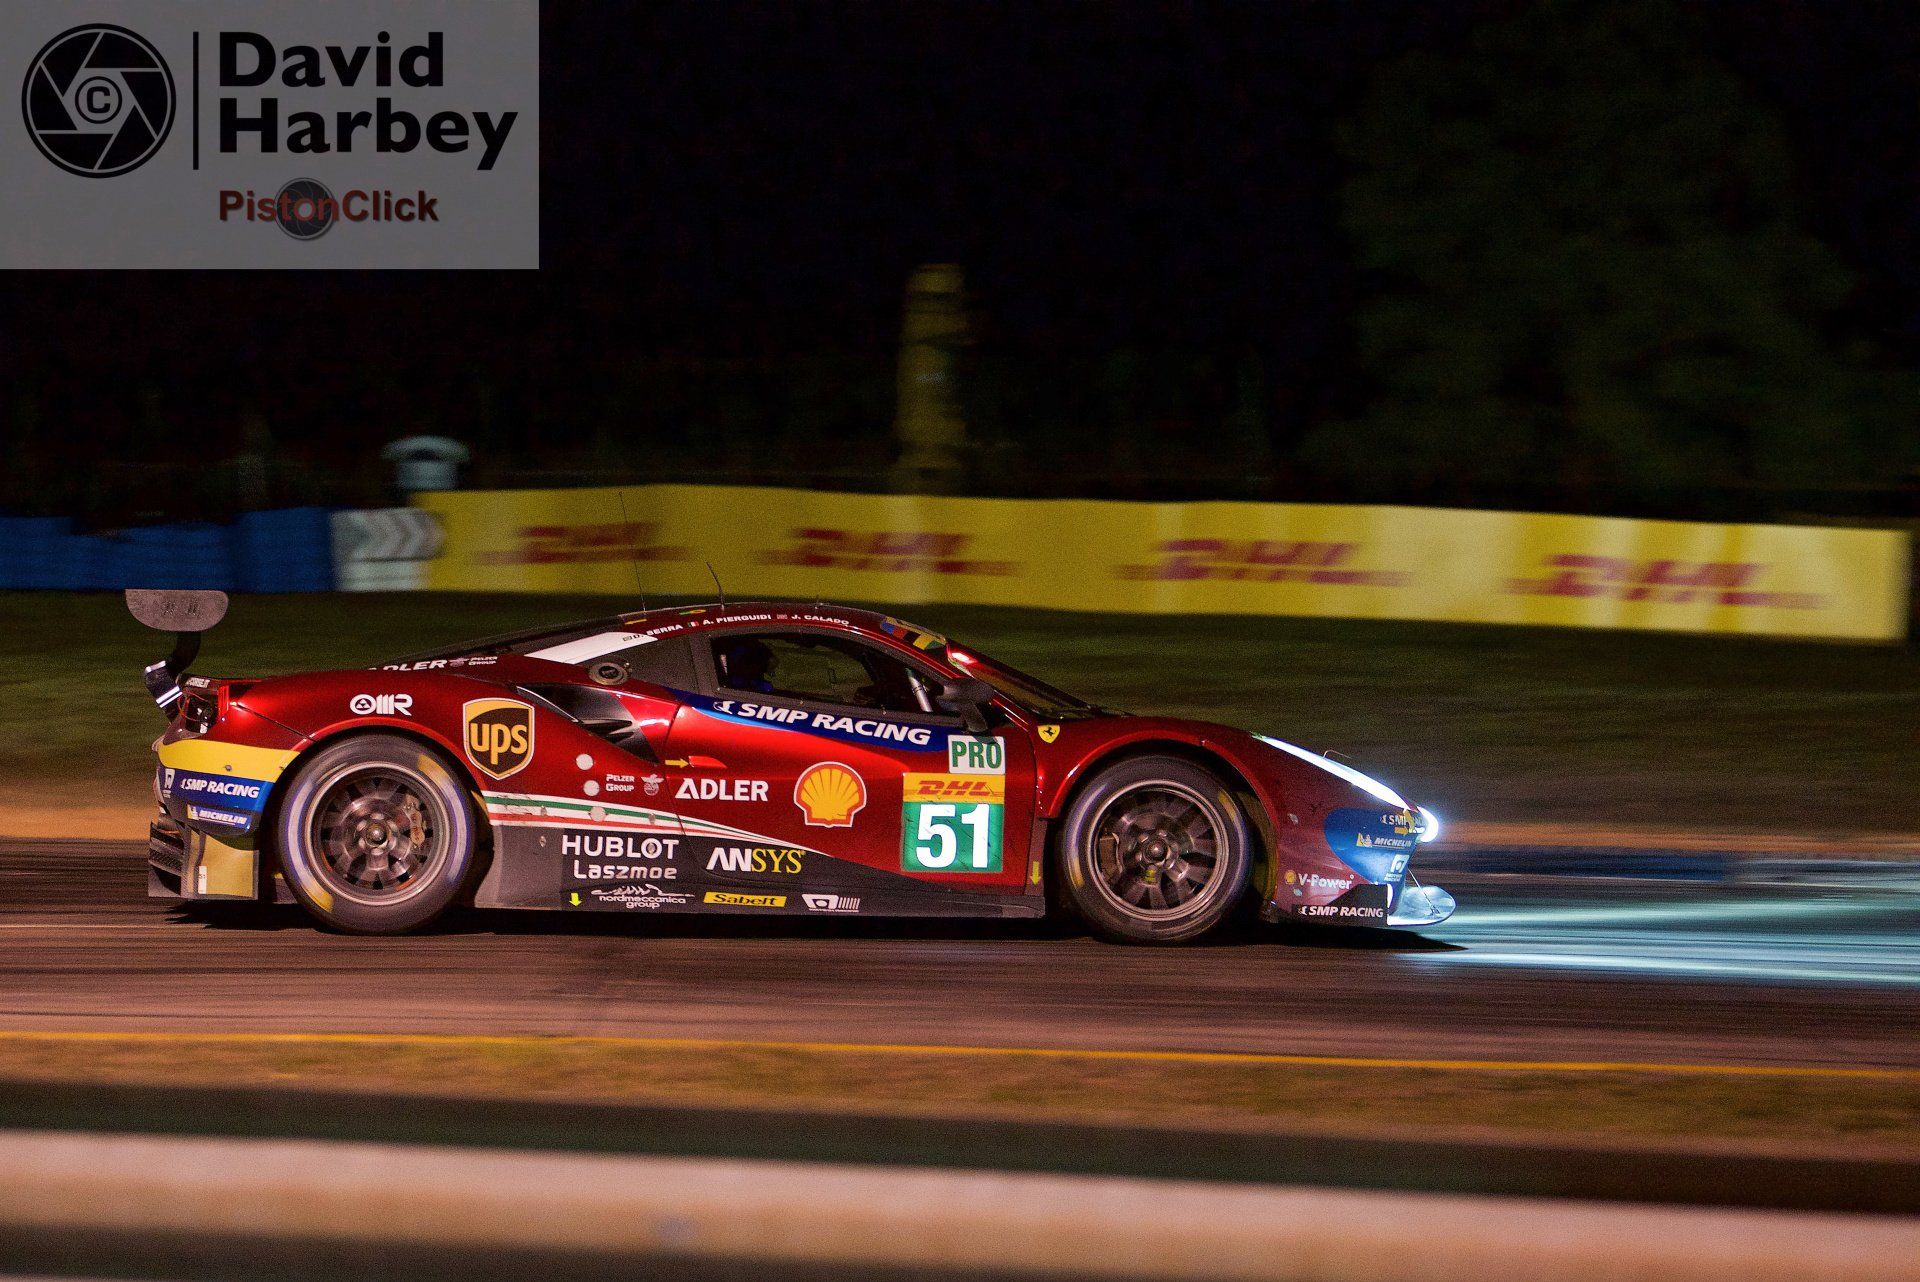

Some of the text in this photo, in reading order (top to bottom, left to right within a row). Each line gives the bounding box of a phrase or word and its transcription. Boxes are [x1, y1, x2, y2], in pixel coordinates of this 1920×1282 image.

[716, 614, 772, 624] PIERGUIDI
[804, 615, 850, 625] CALADO
[737, 704, 932, 745] SMP RACING
[470, 722, 528, 766] ups
[951, 740, 1003, 769] PRO
[184, 778, 261, 799] SMP RACING
[675, 778, 769, 802] ADLER
[915, 780, 991, 796] DHL
[198, 808, 248, 825] MICHELIN
[916, 803, 990, 869] 51
[562, 834, 680, 860] HUBLOT
[573, 859, 678, 880] Laszmoe
[706, 847, 803, 874] ANSYS
[1298, 873, 1353, 890] V-Power
[712, 893, 778, 906] Sabelt
[1308, 905, 1384, 918] SMP RACING
